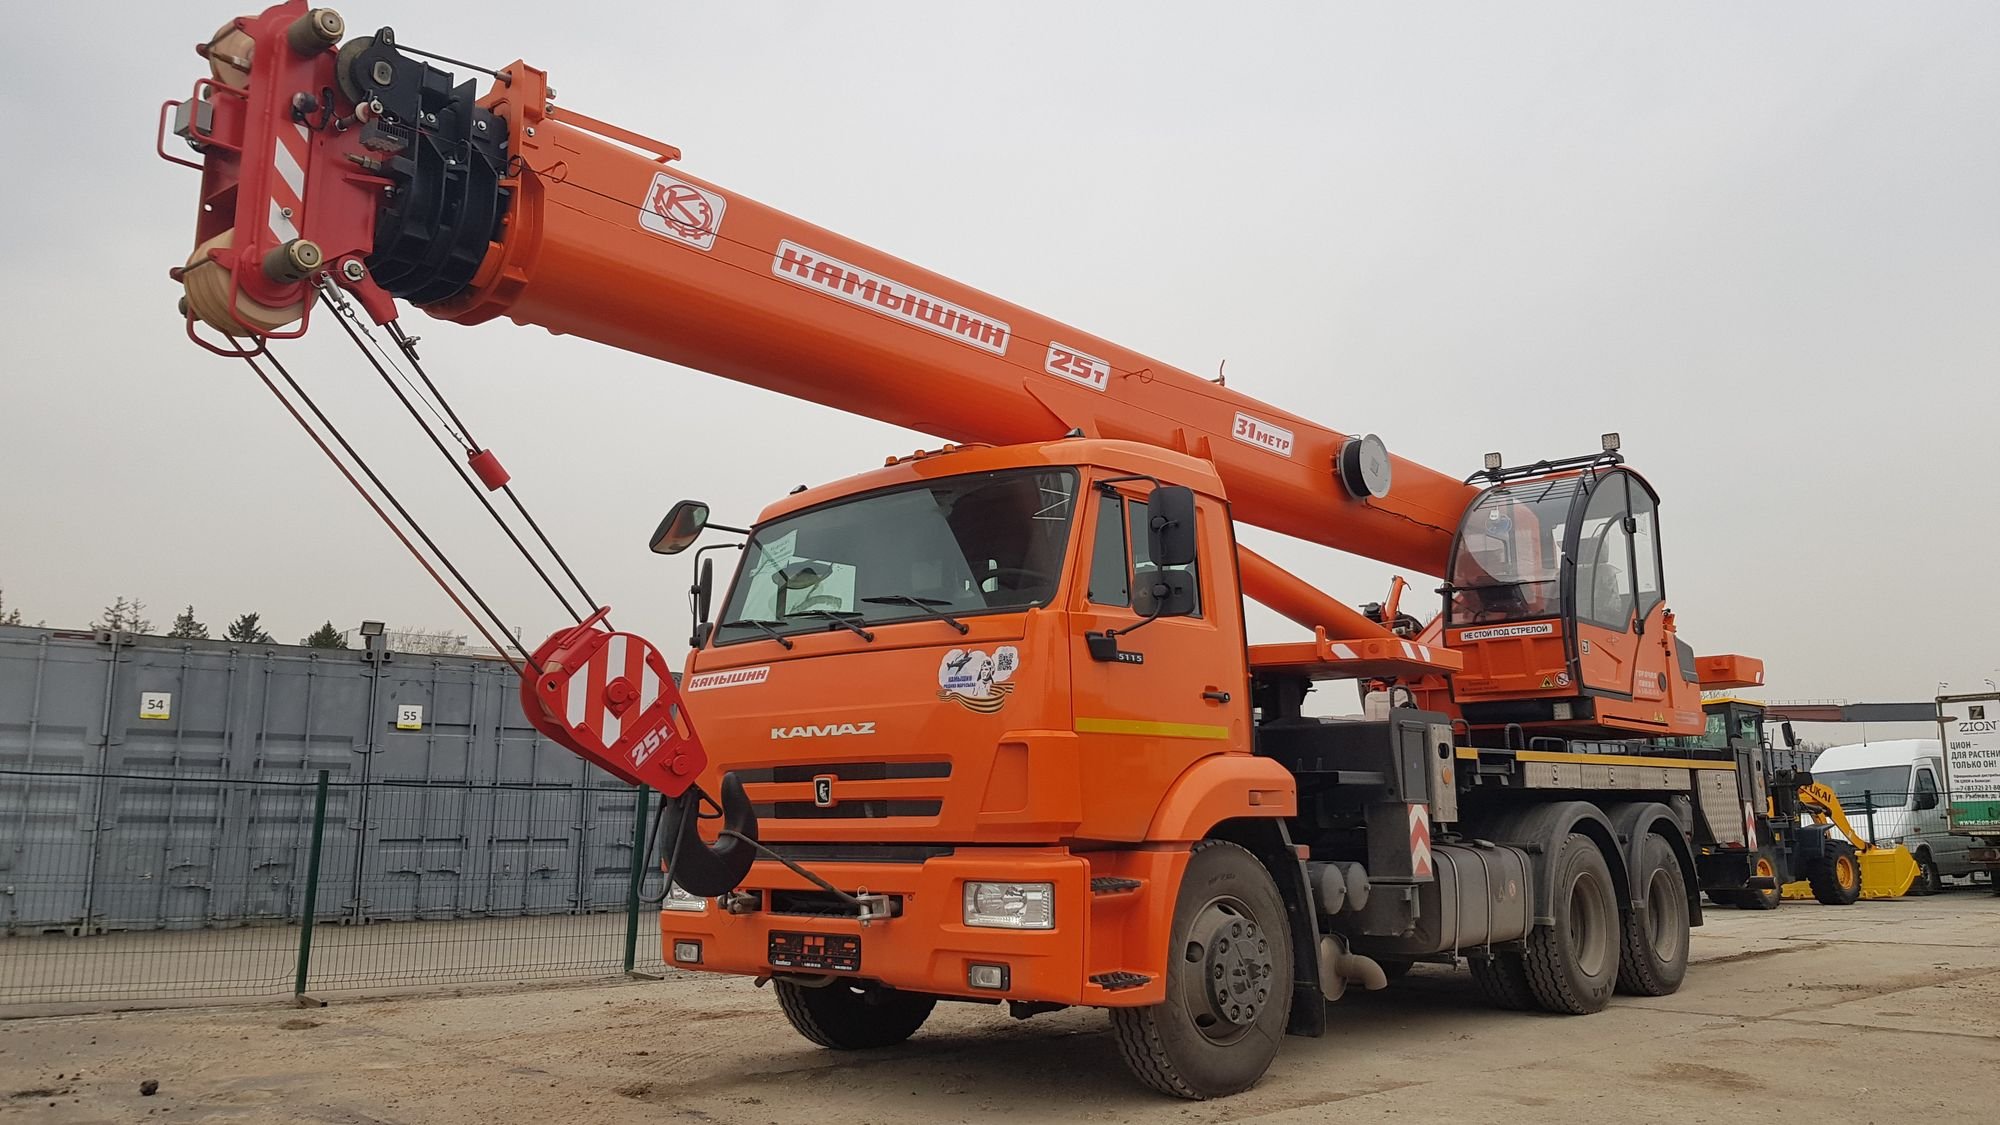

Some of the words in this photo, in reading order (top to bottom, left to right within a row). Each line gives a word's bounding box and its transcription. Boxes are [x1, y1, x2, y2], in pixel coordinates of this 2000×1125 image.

[779, 248, 1006, 349] КАМЫШИН
[1464, 632, 1473, 640] НЕ
[1473, 630, 1493, 639] СТОЙ
[1493, 628, 1510, 637] ПОД
[1510, 625, 1548, 635] СТРЕЛОЙ
[1118, 653, 1143, 662] 5115
[690, 669, 768, 689] КАМЫШИН
[147, 699, 165, 710] 54
[403, 711, 417, 721] 55
[771, 721, 876, 740] KAMAZ
[1959, 721, 1996, 731] ZION
[1950, 741, 1971, 750] ЦИОН
[1951, 751, 1967, 760] ДЛЯ
[1951, 760, 1982, 769] ТОЛЬКО
[1983, 760, 1997, 768] ОН!
